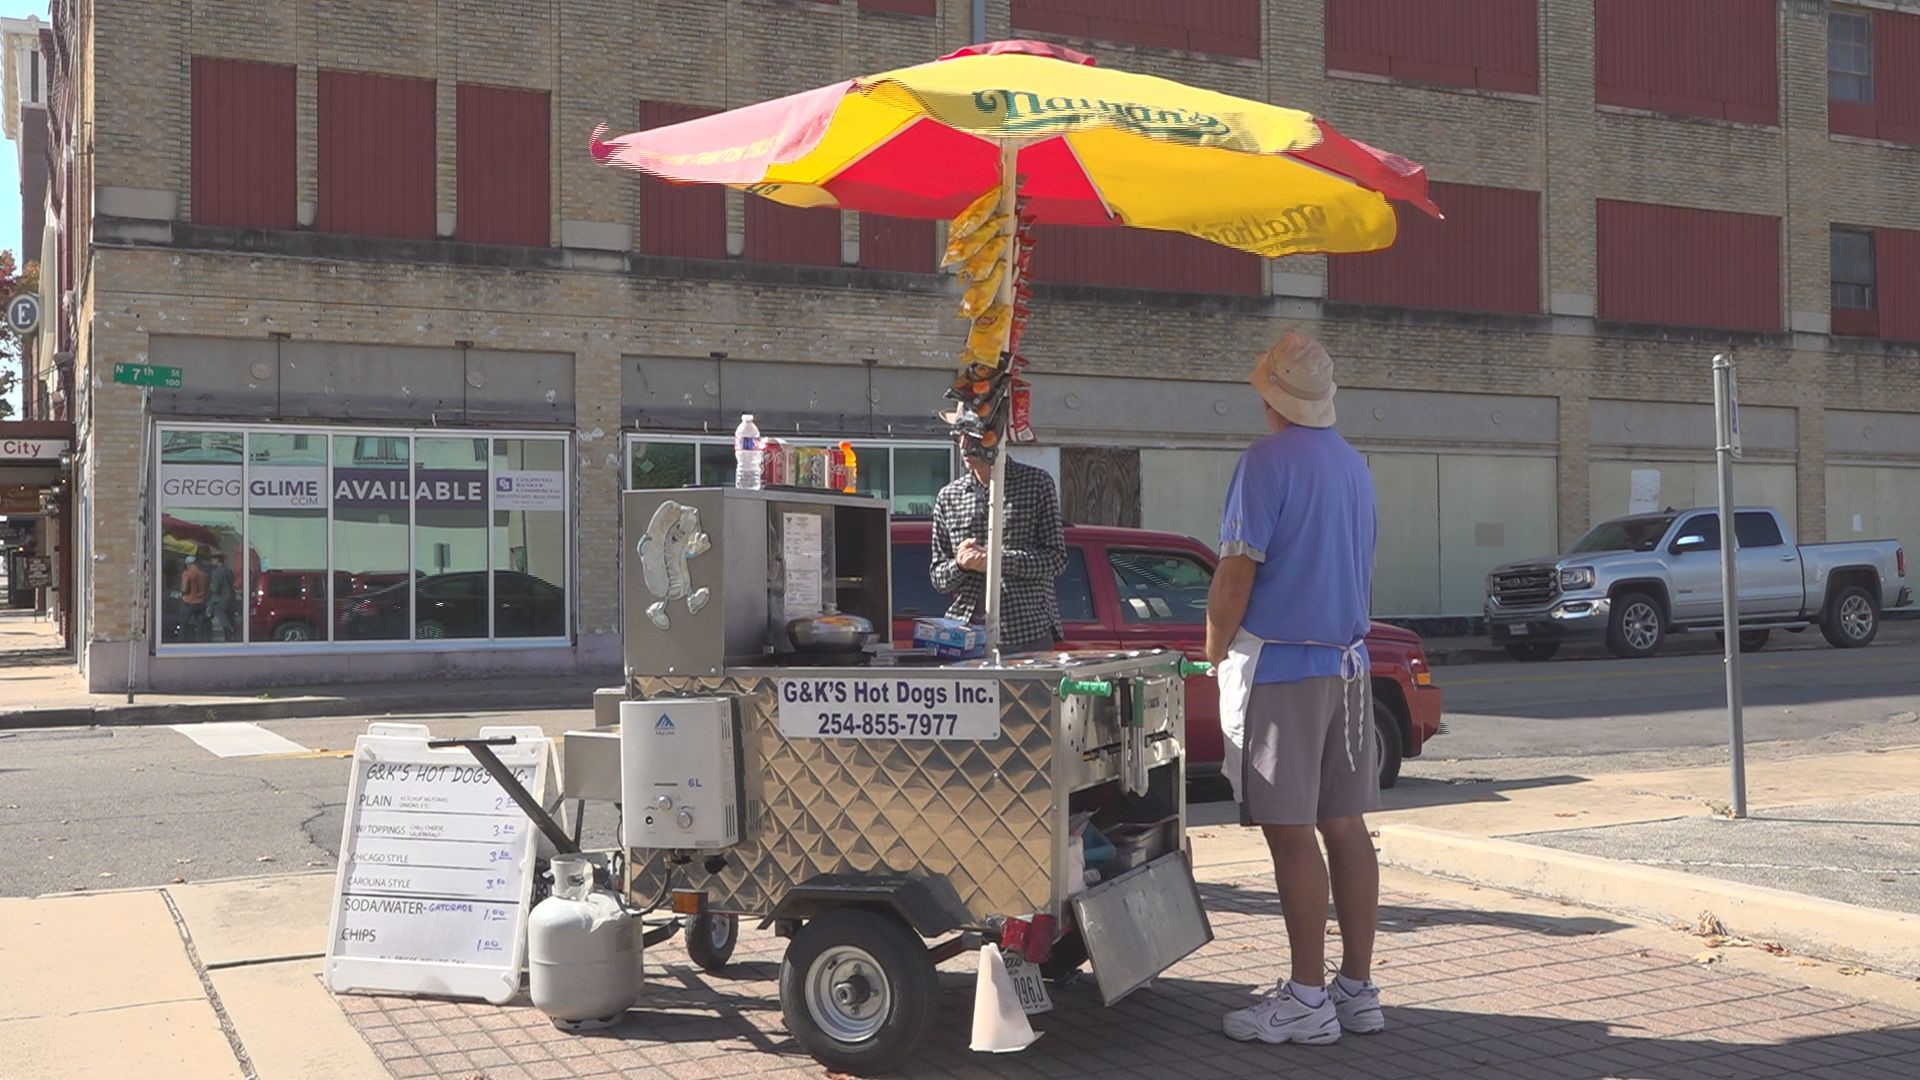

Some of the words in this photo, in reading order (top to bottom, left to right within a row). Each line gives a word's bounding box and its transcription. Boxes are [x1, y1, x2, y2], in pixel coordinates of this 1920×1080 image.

[17, 303, 31, 325] E
[116, 365, 124, 375] N
[166, 379, 180, 387] 100
[3, 441, 42, 456] City
[163, 478, 241, 496] GREGG
[250, 480, 318, 496] GLIME
[335, 480, 483, 501] AVAILABLE
[854, 682, 889, 703] Hot
[896, 682, 947, 709] Dogs
[955, 682, 994, 704] Inc.
[818, 713, 958, 736] 254-855-7977
[415, 765, 449, 783] HOT
[451, 768, 493, 785] DOGS
[688, 778, 702, 787] 6L
[359, 794, 392, 807] PLAIN
[351, 852, 387, 862] CHICAGO
[387, 855, 409, 863] STYLE
[347, 876, 386, 887] CAROLINA
[388, 879, 412, 889] STYLE
[340, 928, 376, 942] CHIPS
